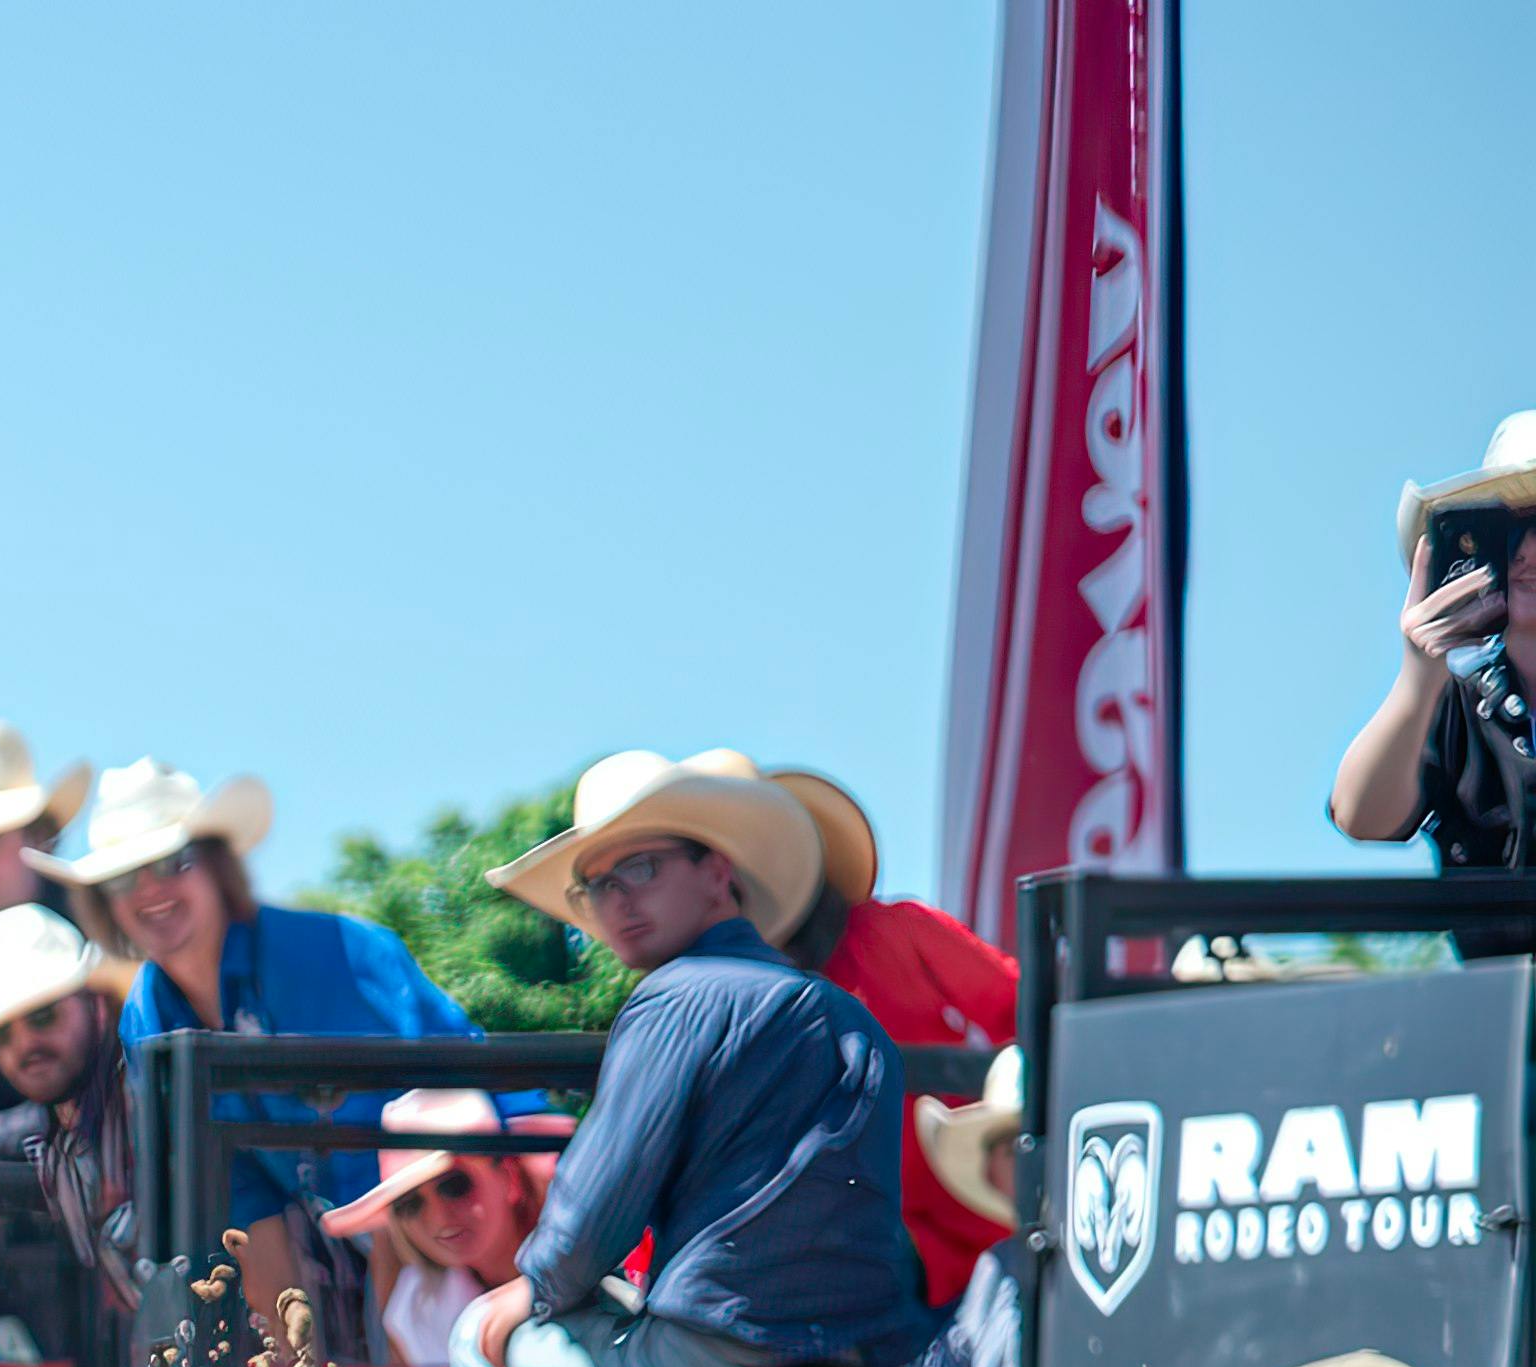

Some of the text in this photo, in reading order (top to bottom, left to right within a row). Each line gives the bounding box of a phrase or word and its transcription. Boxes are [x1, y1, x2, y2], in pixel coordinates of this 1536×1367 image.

[1177, 1094, 1482, 1208] RAM
[1175, 1193, 1483, 1264] RODEO TOUR
